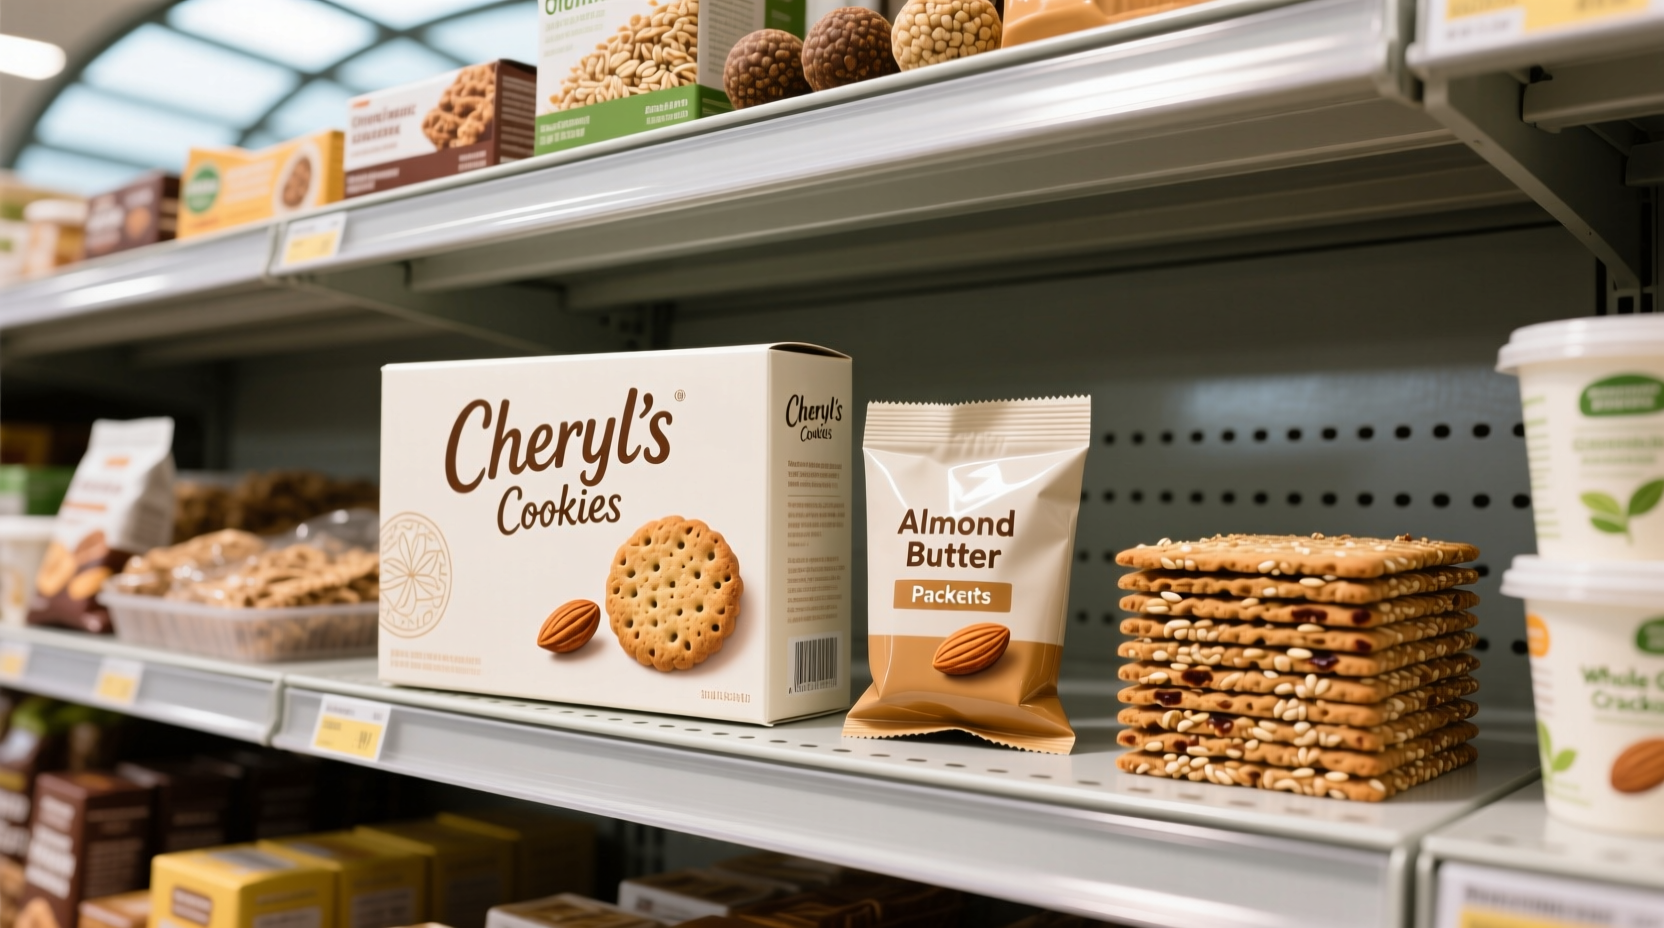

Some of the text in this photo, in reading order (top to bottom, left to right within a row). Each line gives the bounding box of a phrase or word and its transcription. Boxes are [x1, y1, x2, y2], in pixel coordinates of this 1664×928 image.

[785, 394, 842, 428] Cheryl's
[445, 387, 673, 494] Cheryl's
[497, 484, 622, 536] Cookies
[897, 508, 1015, 537] Almond
[906, 541, 1002, 568] Butter
